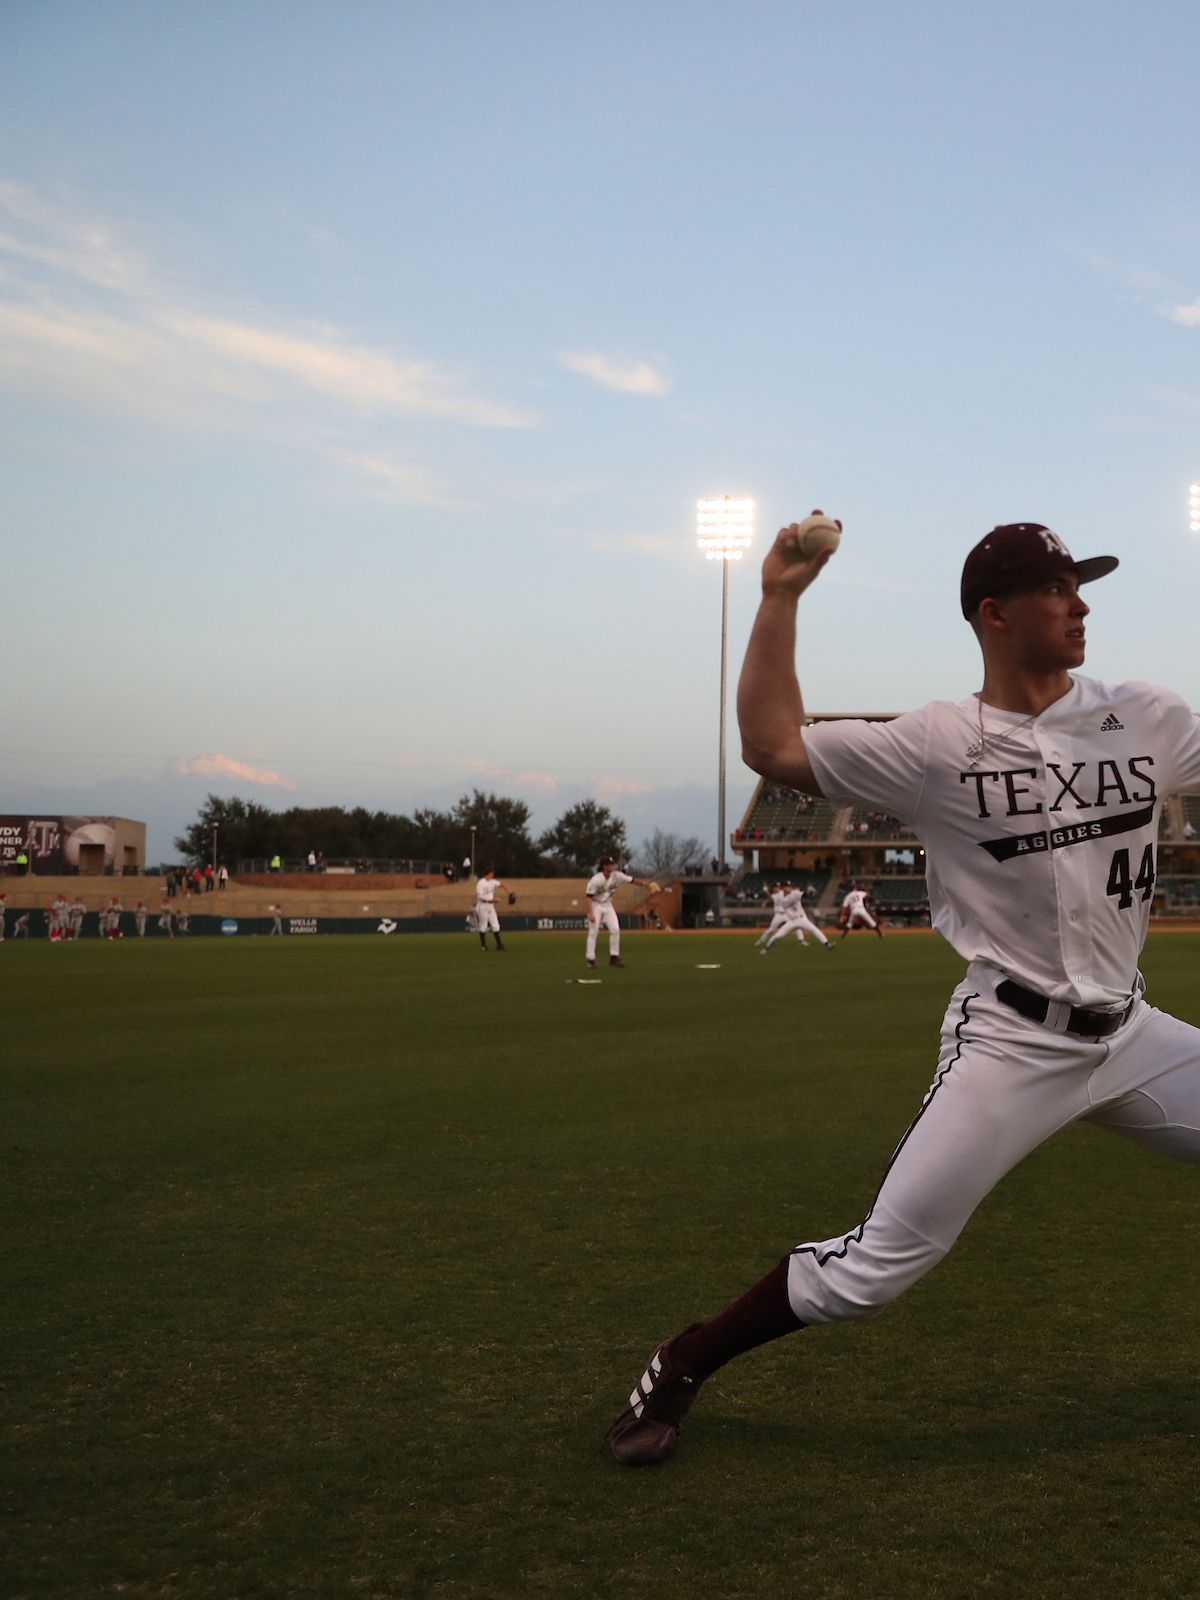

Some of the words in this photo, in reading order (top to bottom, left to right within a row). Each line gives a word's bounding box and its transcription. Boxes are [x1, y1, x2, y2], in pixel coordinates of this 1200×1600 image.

[1100, 723, 1125, 731] adidas
[960, 756, 1156, 818] TEXAS
[1016, 823, 1103, 851] AGGIES
[1106, 842, 1155, 911] 44
